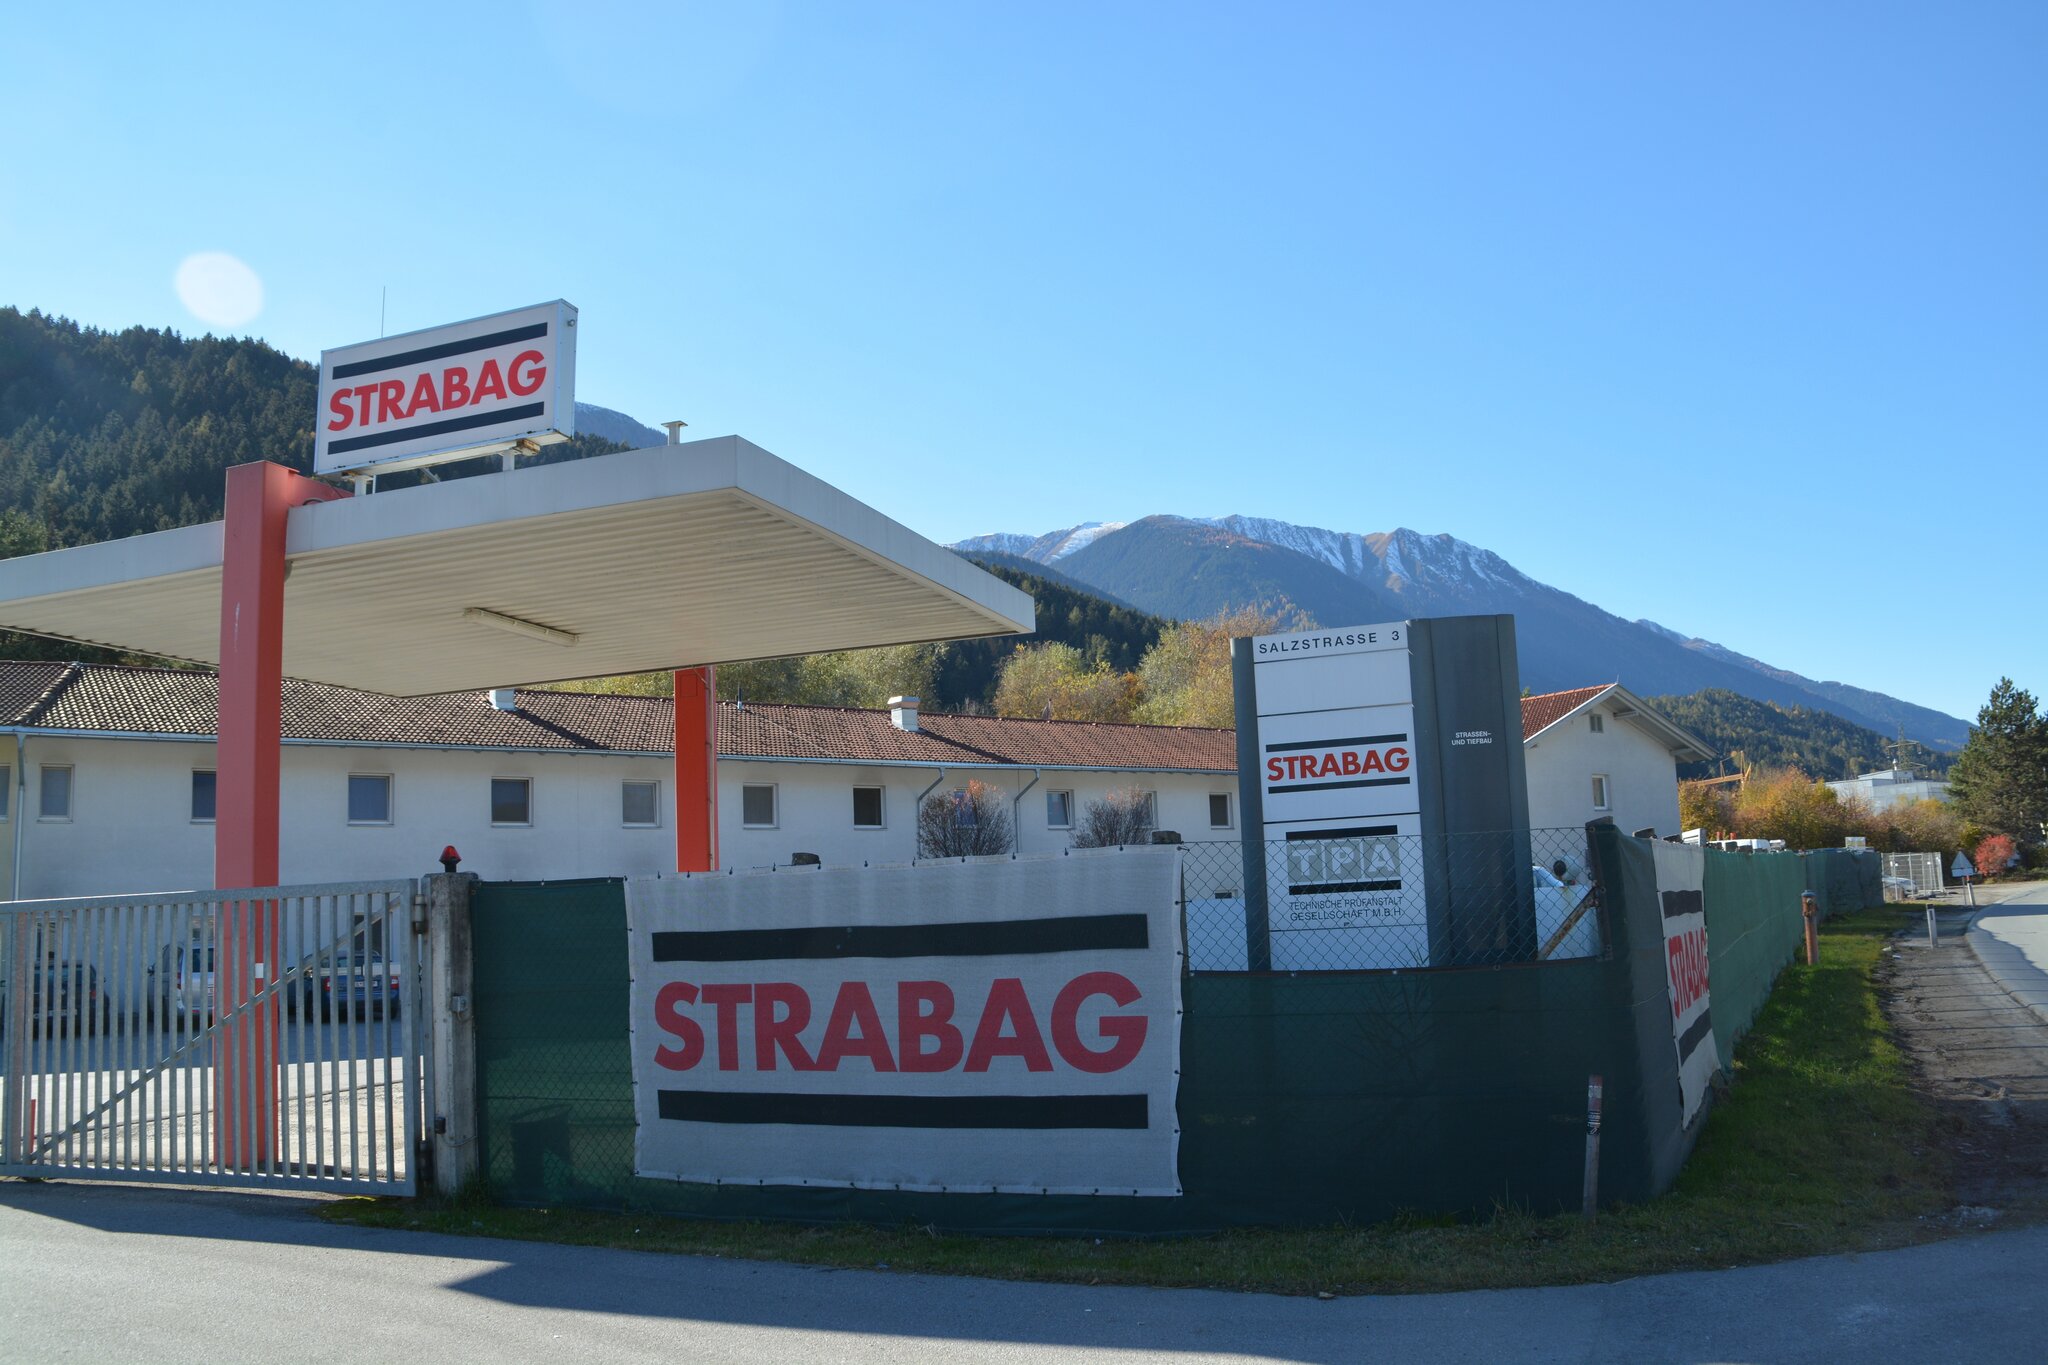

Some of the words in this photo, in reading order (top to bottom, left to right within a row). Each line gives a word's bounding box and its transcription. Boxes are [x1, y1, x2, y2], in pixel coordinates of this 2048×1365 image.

[328, 350, 546, 431] STRABAG
[1259, 632, 1377, 654] SALZSTRASSE
[1391, 630, 1400, 641] 3
[1466, 737, 1493, 745] TIEFBAU
[1267, 747, 1409, 781] STRABAG
[1291, 844, 1397, 876] TPA
[1290, 900, 1343, 911] TECHNISCHE
[1290, 909, 1370, 921] GESELLSCHAFT
[654, 971, 1148, 1074] STRABAG
